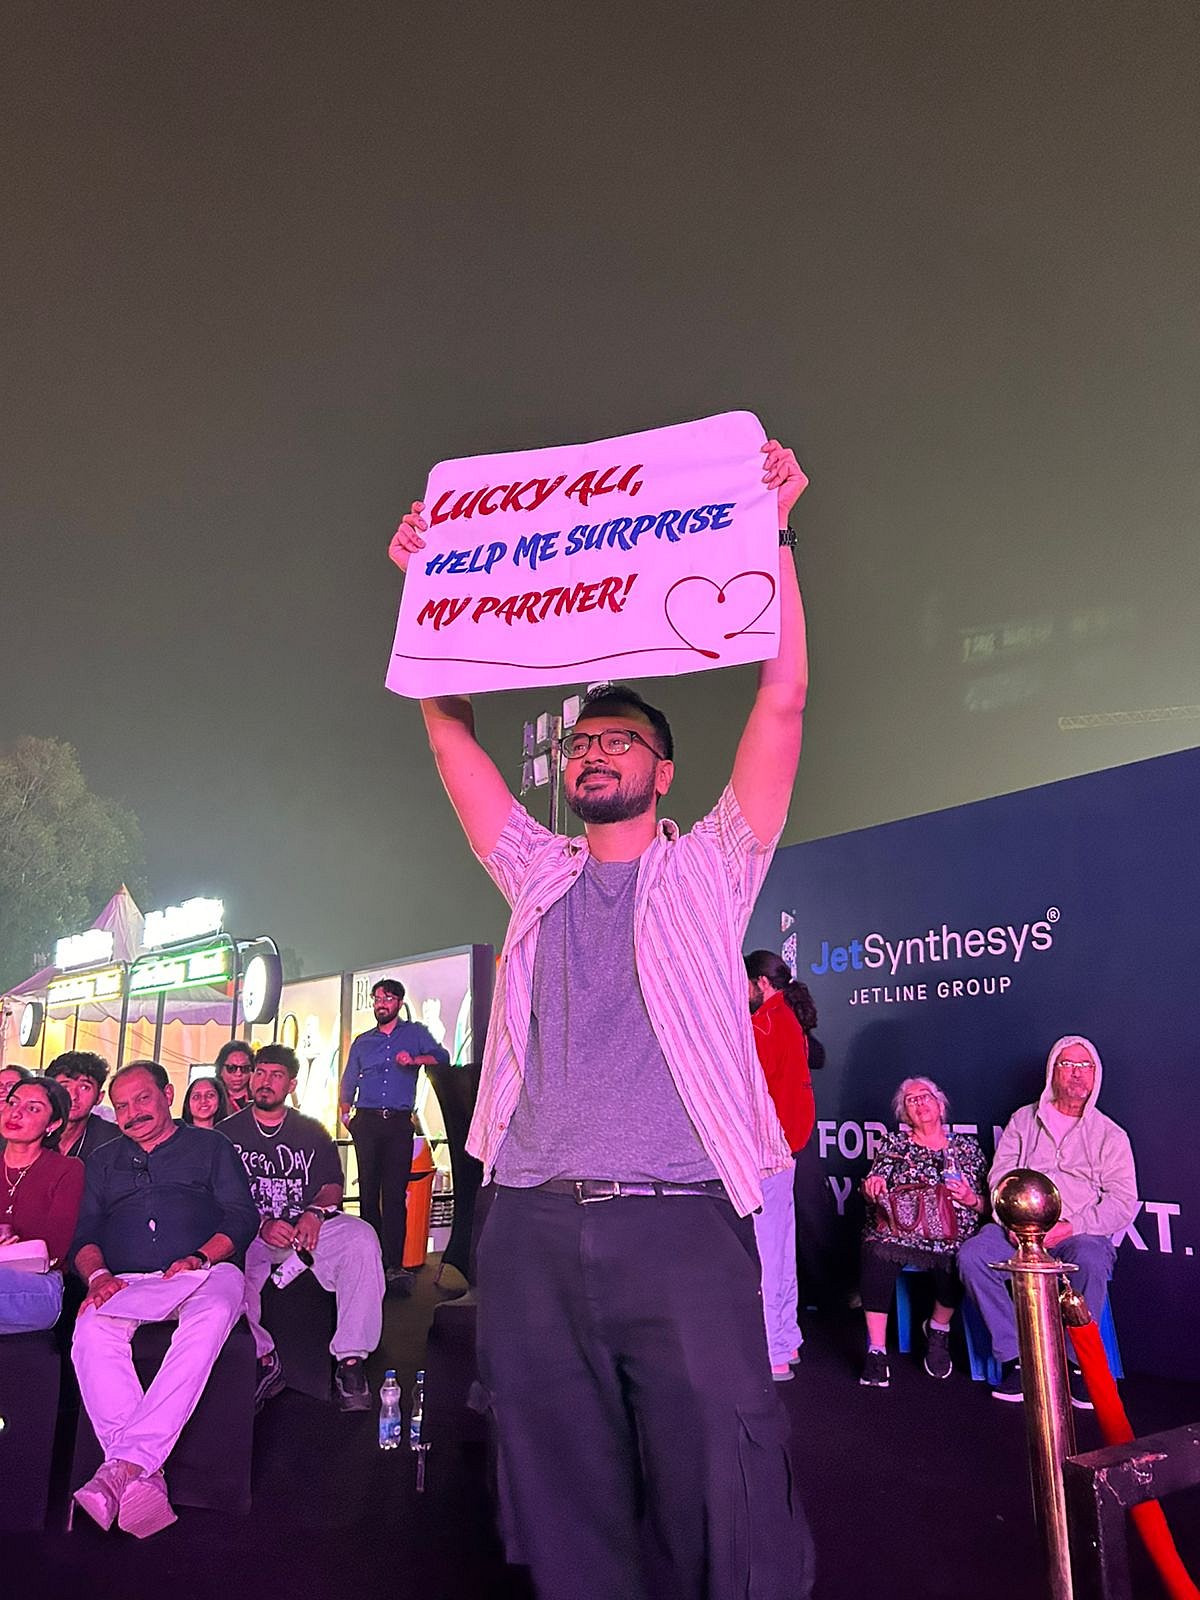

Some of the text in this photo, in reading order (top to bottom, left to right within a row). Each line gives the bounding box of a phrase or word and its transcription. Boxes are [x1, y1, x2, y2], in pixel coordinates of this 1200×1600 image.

[430, 464, 643, 528] LUCKY ALI,
[425, 502, 736, 576] HELP ME SURPRISE
[417, 573, 638, 631] MY PARTNER!
[849, 976, 1012, 1006] JETLINE GROUP
[275, 1144, 316, 1185] DAY
